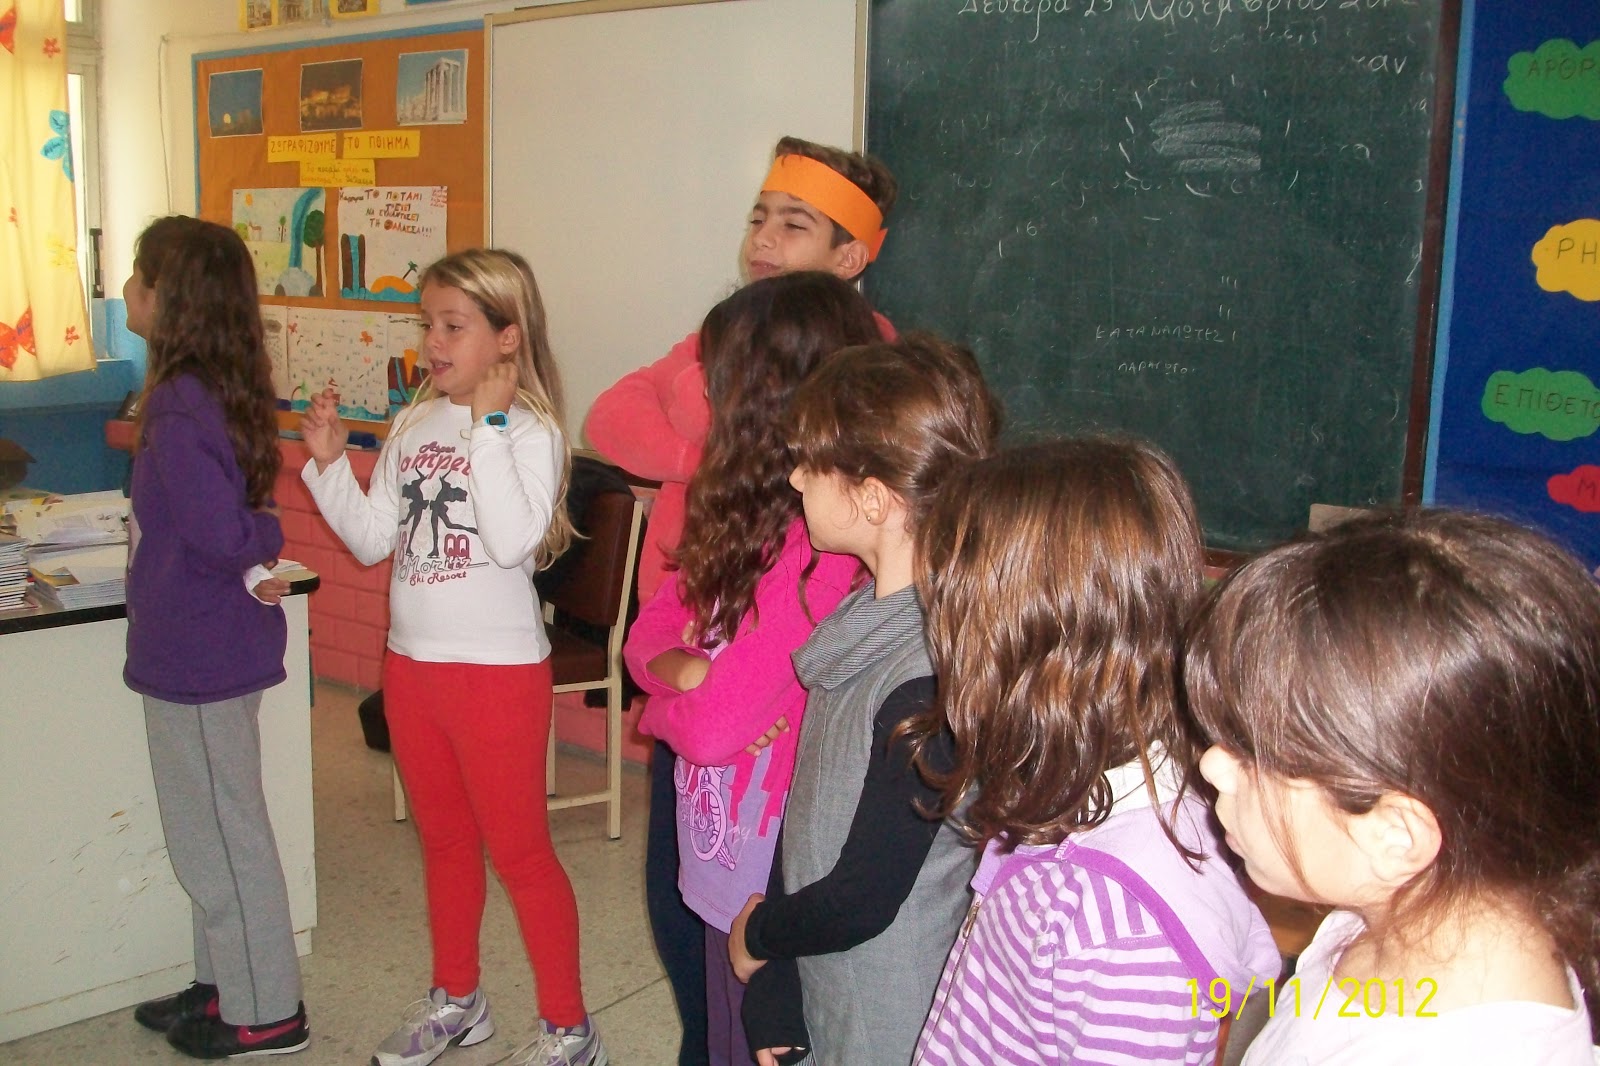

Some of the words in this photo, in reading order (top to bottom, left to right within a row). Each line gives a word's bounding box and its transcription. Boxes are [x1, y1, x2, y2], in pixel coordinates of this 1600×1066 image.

[346, 135, 360, 150] ΤΟ
[369, 135, 411, 151] ΠΟΙΗΜΑ
[409, 571, 425, 586] Ski
[427, 570, 467, 585] Resort
